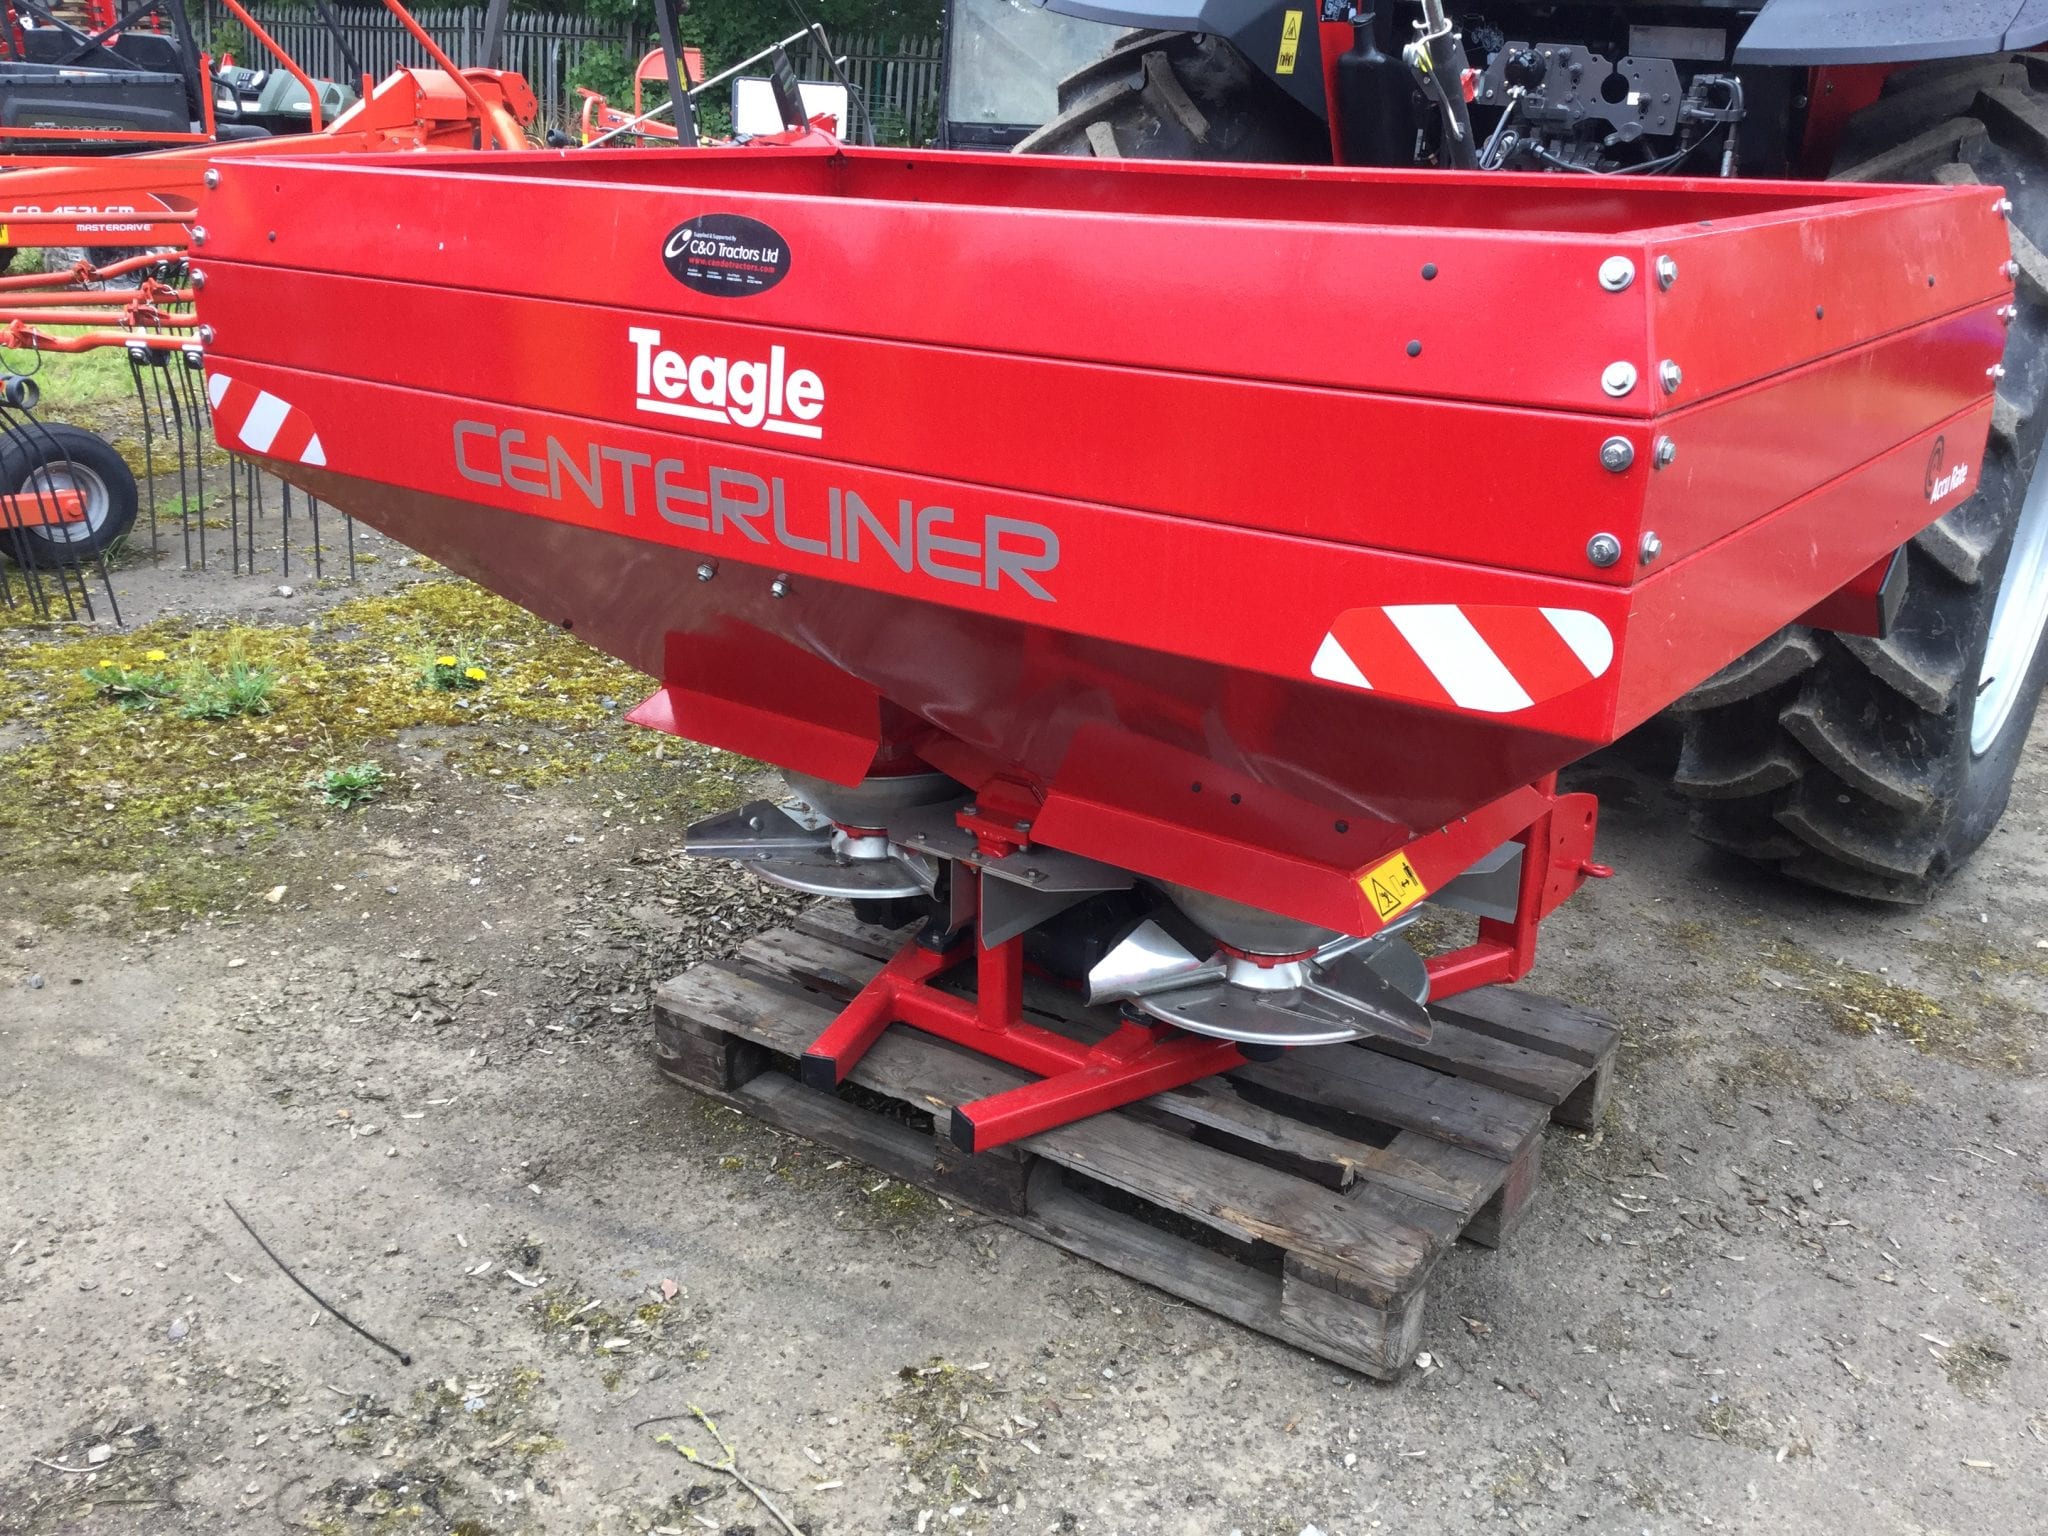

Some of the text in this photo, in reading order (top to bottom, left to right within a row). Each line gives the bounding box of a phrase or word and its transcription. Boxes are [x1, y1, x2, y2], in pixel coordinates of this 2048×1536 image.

[76, 223, 151, 232] MASTERDRIVE
[690, 239, 779, 264] C&O Tractors Ltd
[628, 326, 825, 429] Teagle
[452, 419, 1061, 602] CENTERLINER
